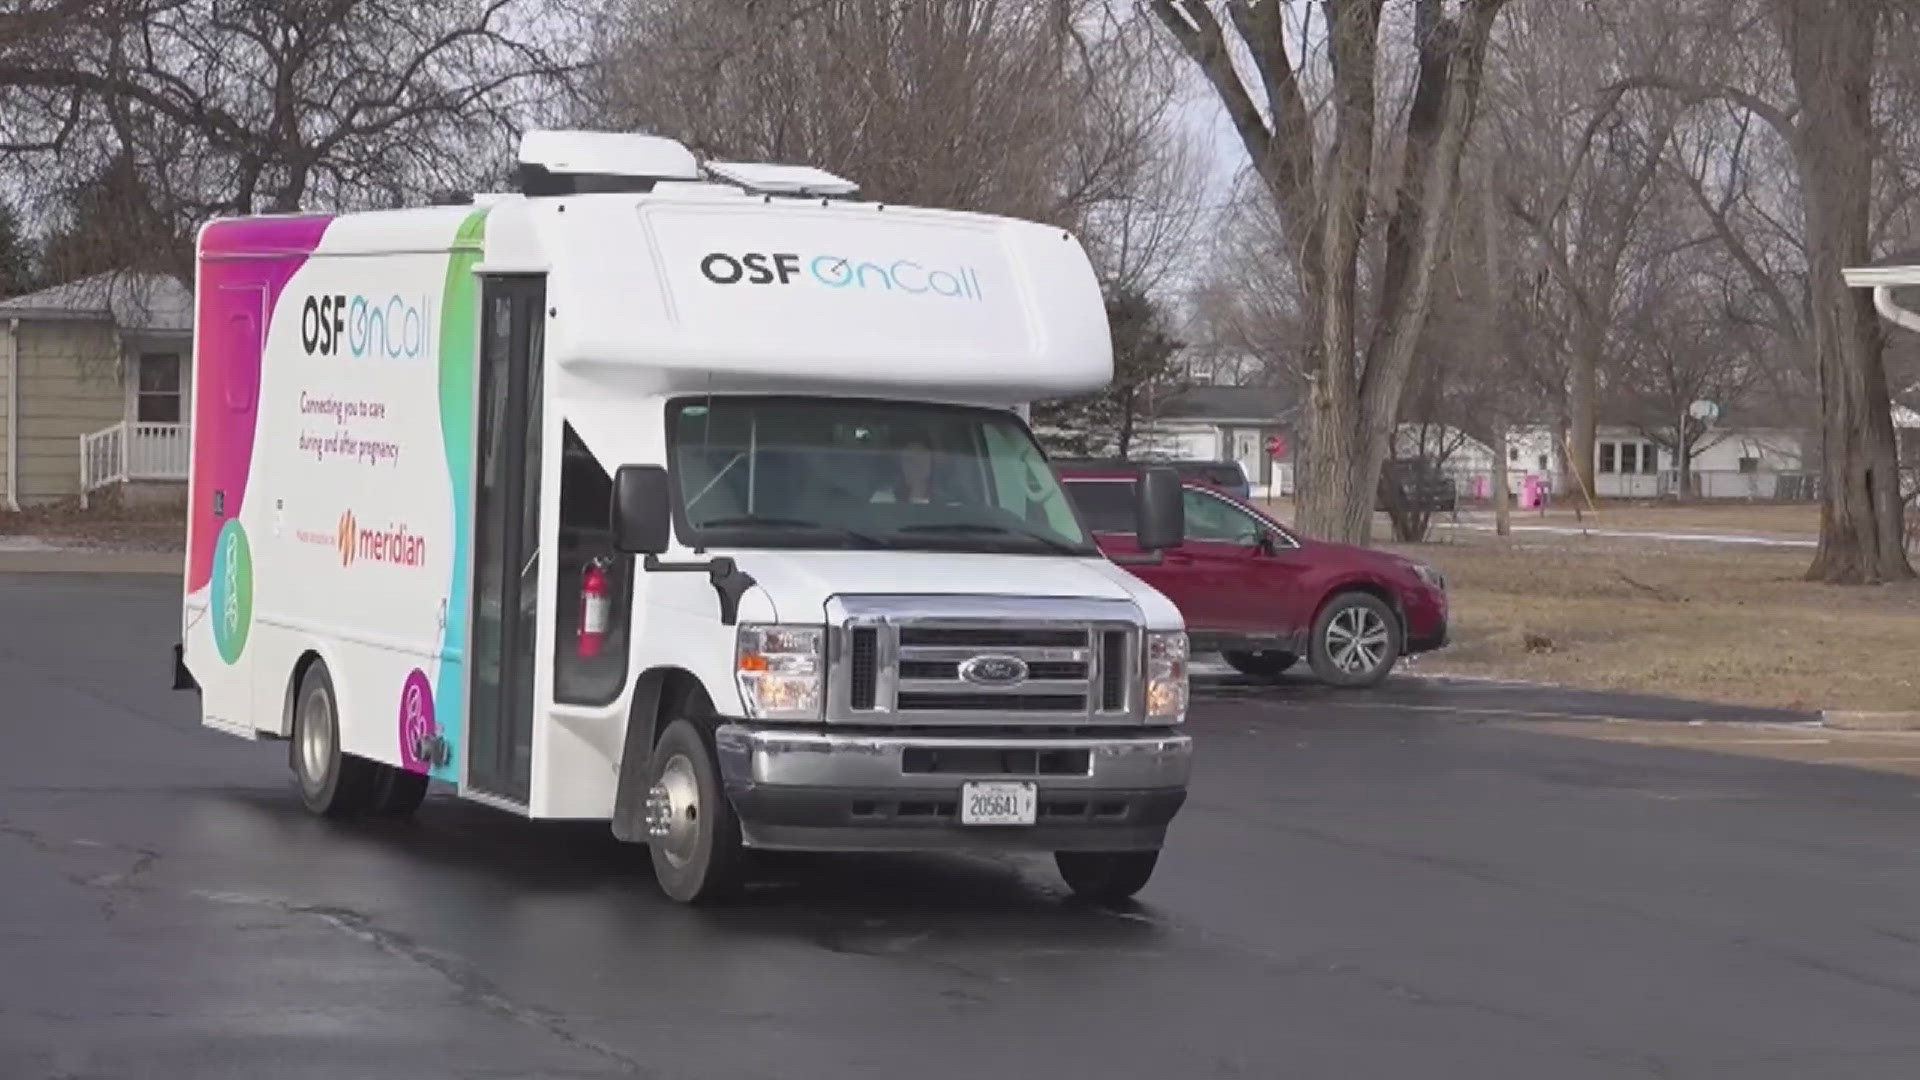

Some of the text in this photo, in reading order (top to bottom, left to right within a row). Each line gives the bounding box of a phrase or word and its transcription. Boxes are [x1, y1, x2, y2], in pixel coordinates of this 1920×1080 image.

[700, 252, 983, 303] OSF OnCall
[302, 294, 431, 358] OSF OnCall
[300, 391, 385, 425] Connecting you to care
[299, 429, 399, 469] during and after pregnancy
[358, 522, 426, 567] meridian
[970, 794, 1018, 816] 205641
